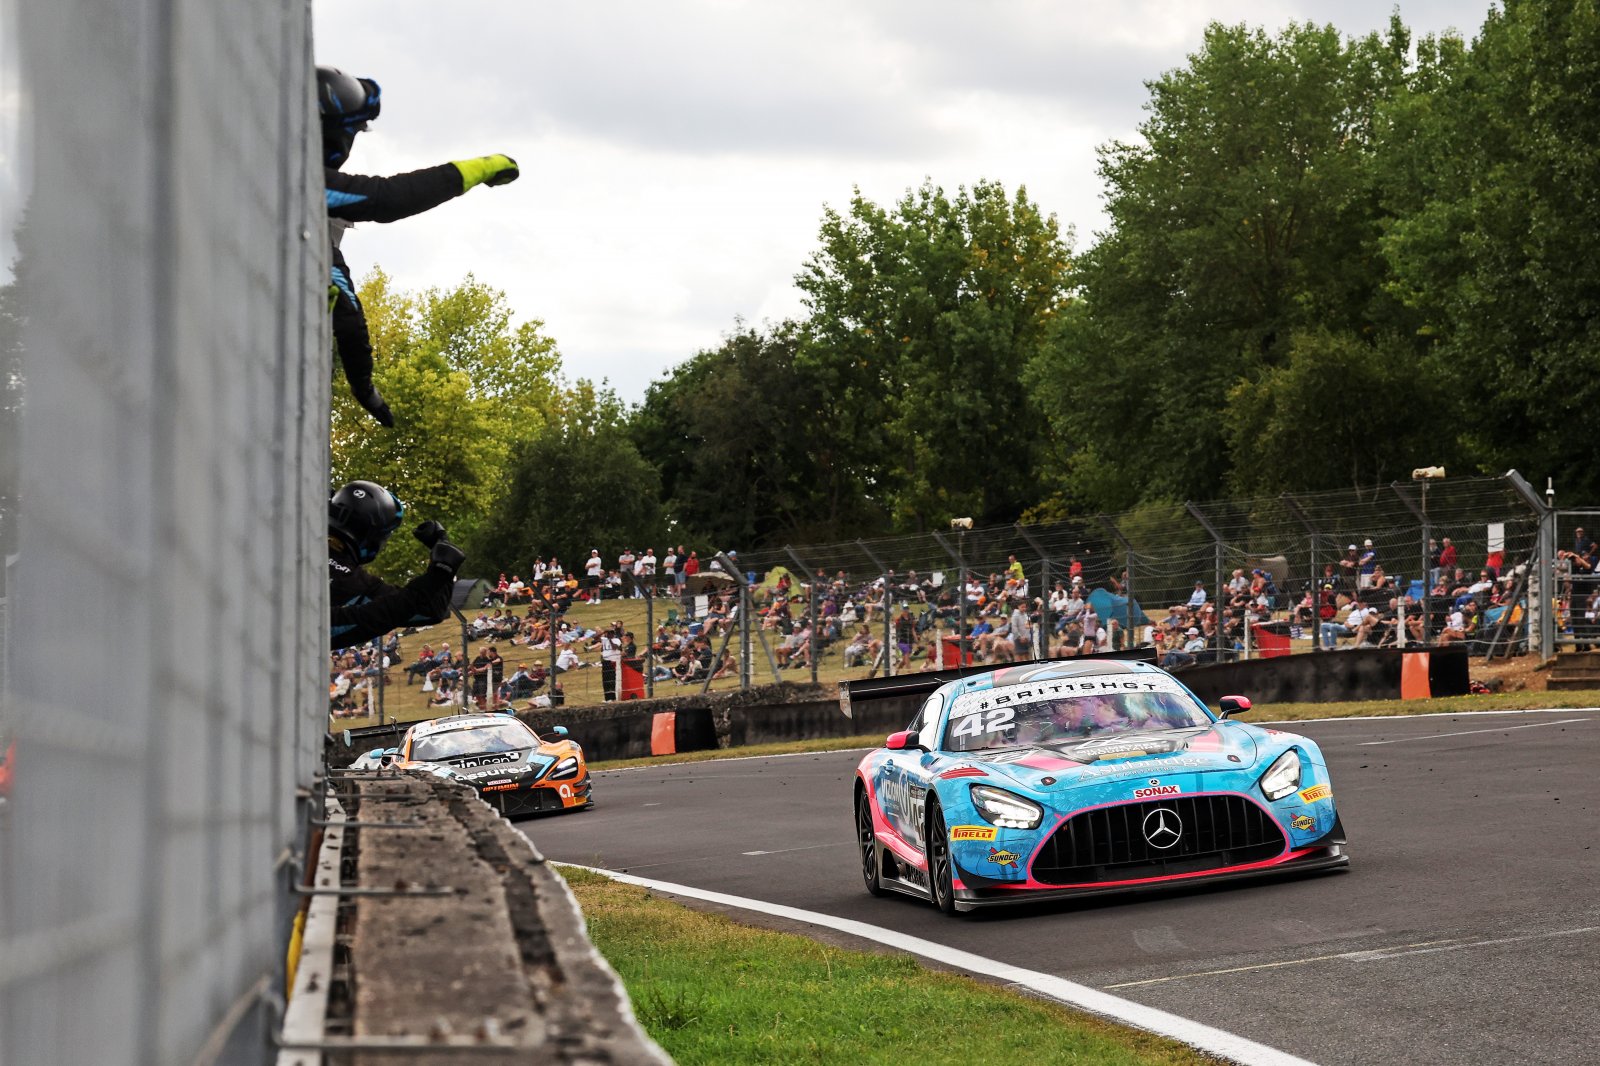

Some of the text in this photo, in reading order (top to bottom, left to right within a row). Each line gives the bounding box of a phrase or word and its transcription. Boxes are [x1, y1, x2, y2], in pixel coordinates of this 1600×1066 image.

[952, 707, 1016, 738] 42
[454, 764, 533, 781] assured
[1078, 756, 1209, 782] Ashbridge
[1135, 785, 1178, 799] SONAX
[1292, 817, 1315, 828] SUNOCO
[953, 828, 994, 838] PIRELLI
[989, 854, 1019, 862] SUNOCO
